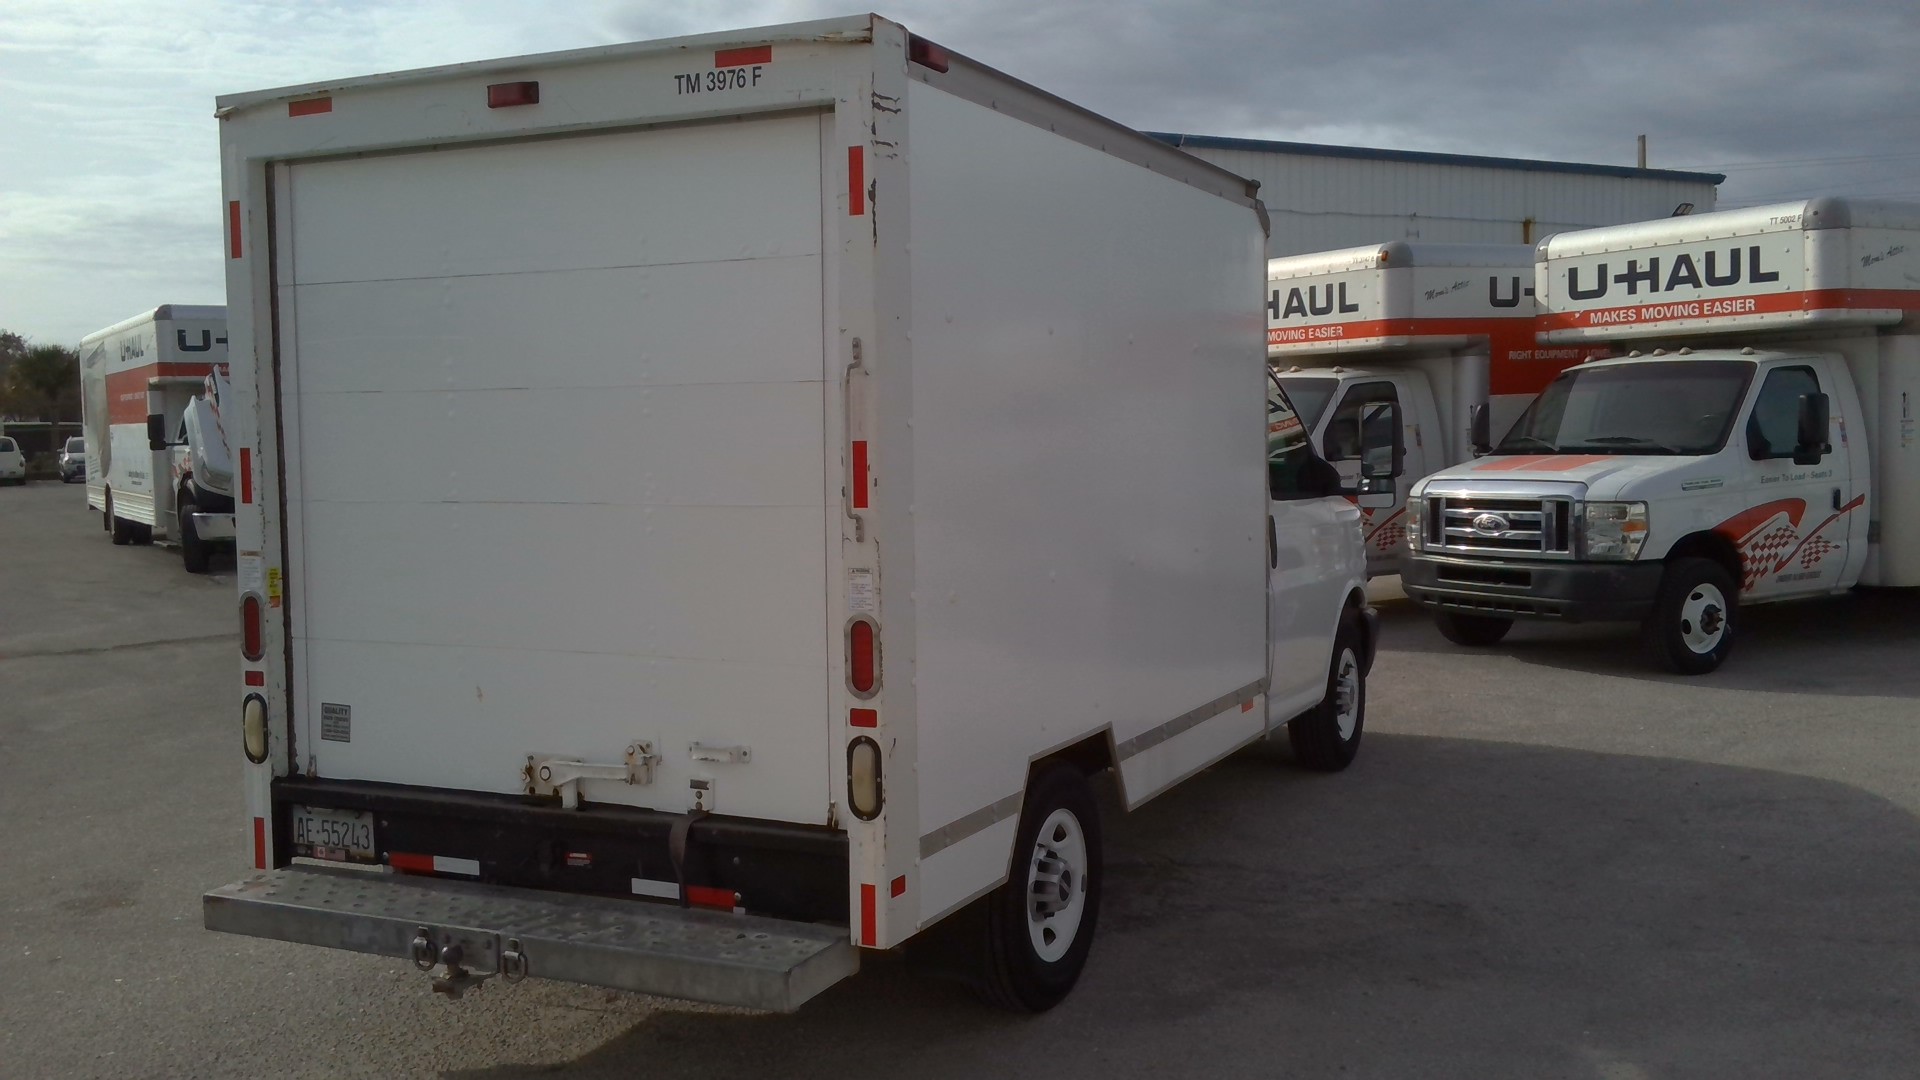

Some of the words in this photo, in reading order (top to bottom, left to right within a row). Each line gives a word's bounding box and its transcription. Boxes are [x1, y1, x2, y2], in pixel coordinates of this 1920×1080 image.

[674, 73, 701, 95] TM
[706, 68, 746, 92] 3976
[752, 66, 762, 87] F
[1567, 245, 1780, 301] U-HAUL
[1590, 304, 1637, 325] MAKES
[1641, 300, 1700, 320] MOVING
[1703, 296, 1756, 315] EASIER
[1268, 328, 1306, 342] MOVING
[1308, 325, 1344, 340] EASIER
[1509, 350, 1532, 360] RIGHT
[1535, 349, 1579, 360] EQUIPMENT
